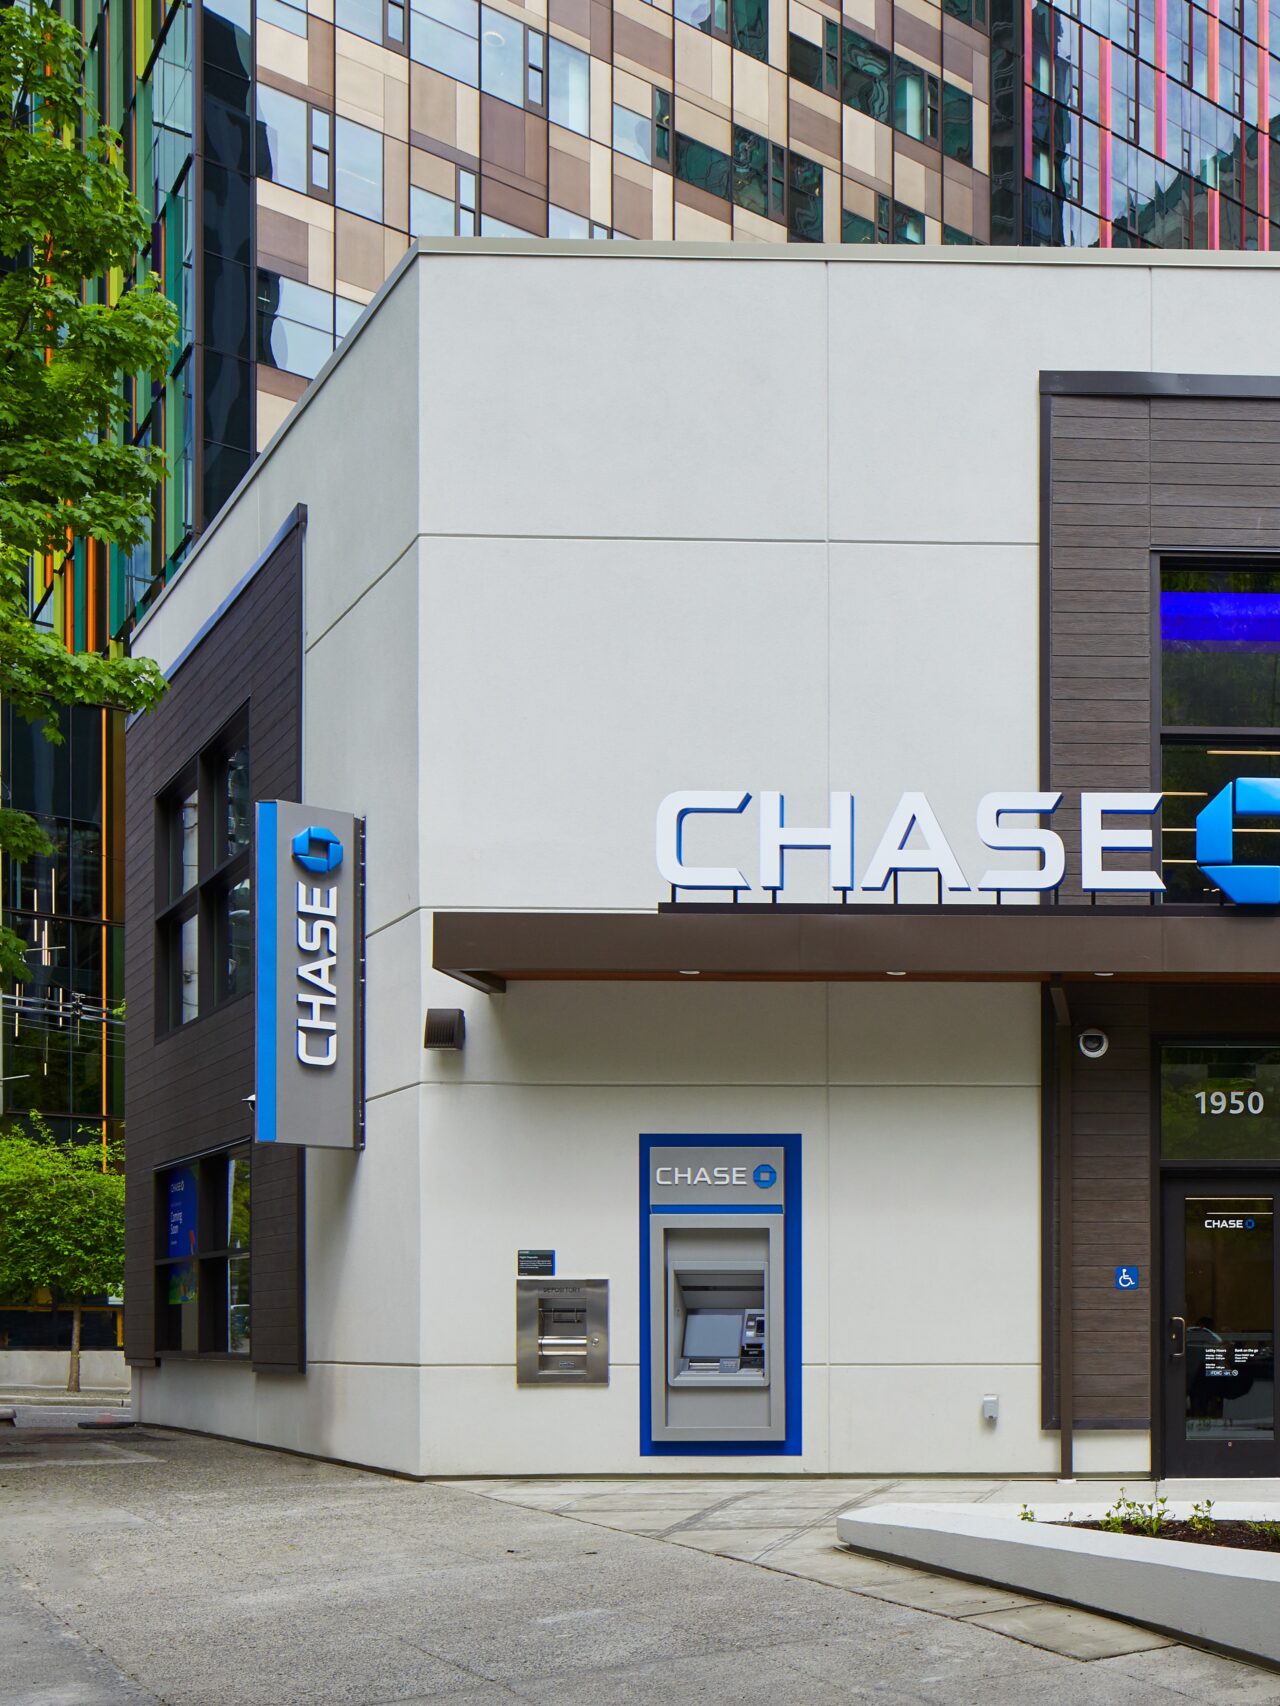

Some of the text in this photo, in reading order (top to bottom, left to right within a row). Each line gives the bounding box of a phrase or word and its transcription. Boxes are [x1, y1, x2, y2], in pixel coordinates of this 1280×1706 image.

[656, 791, 1166, 892] CHASE
[297, 881, 337, 1066] CHASE
[1195, 1091, 1264, 1114] 1950
[656, 1167, 748, 1185] CHASE
[1204, 1219, 1244, 1229] CHASE
